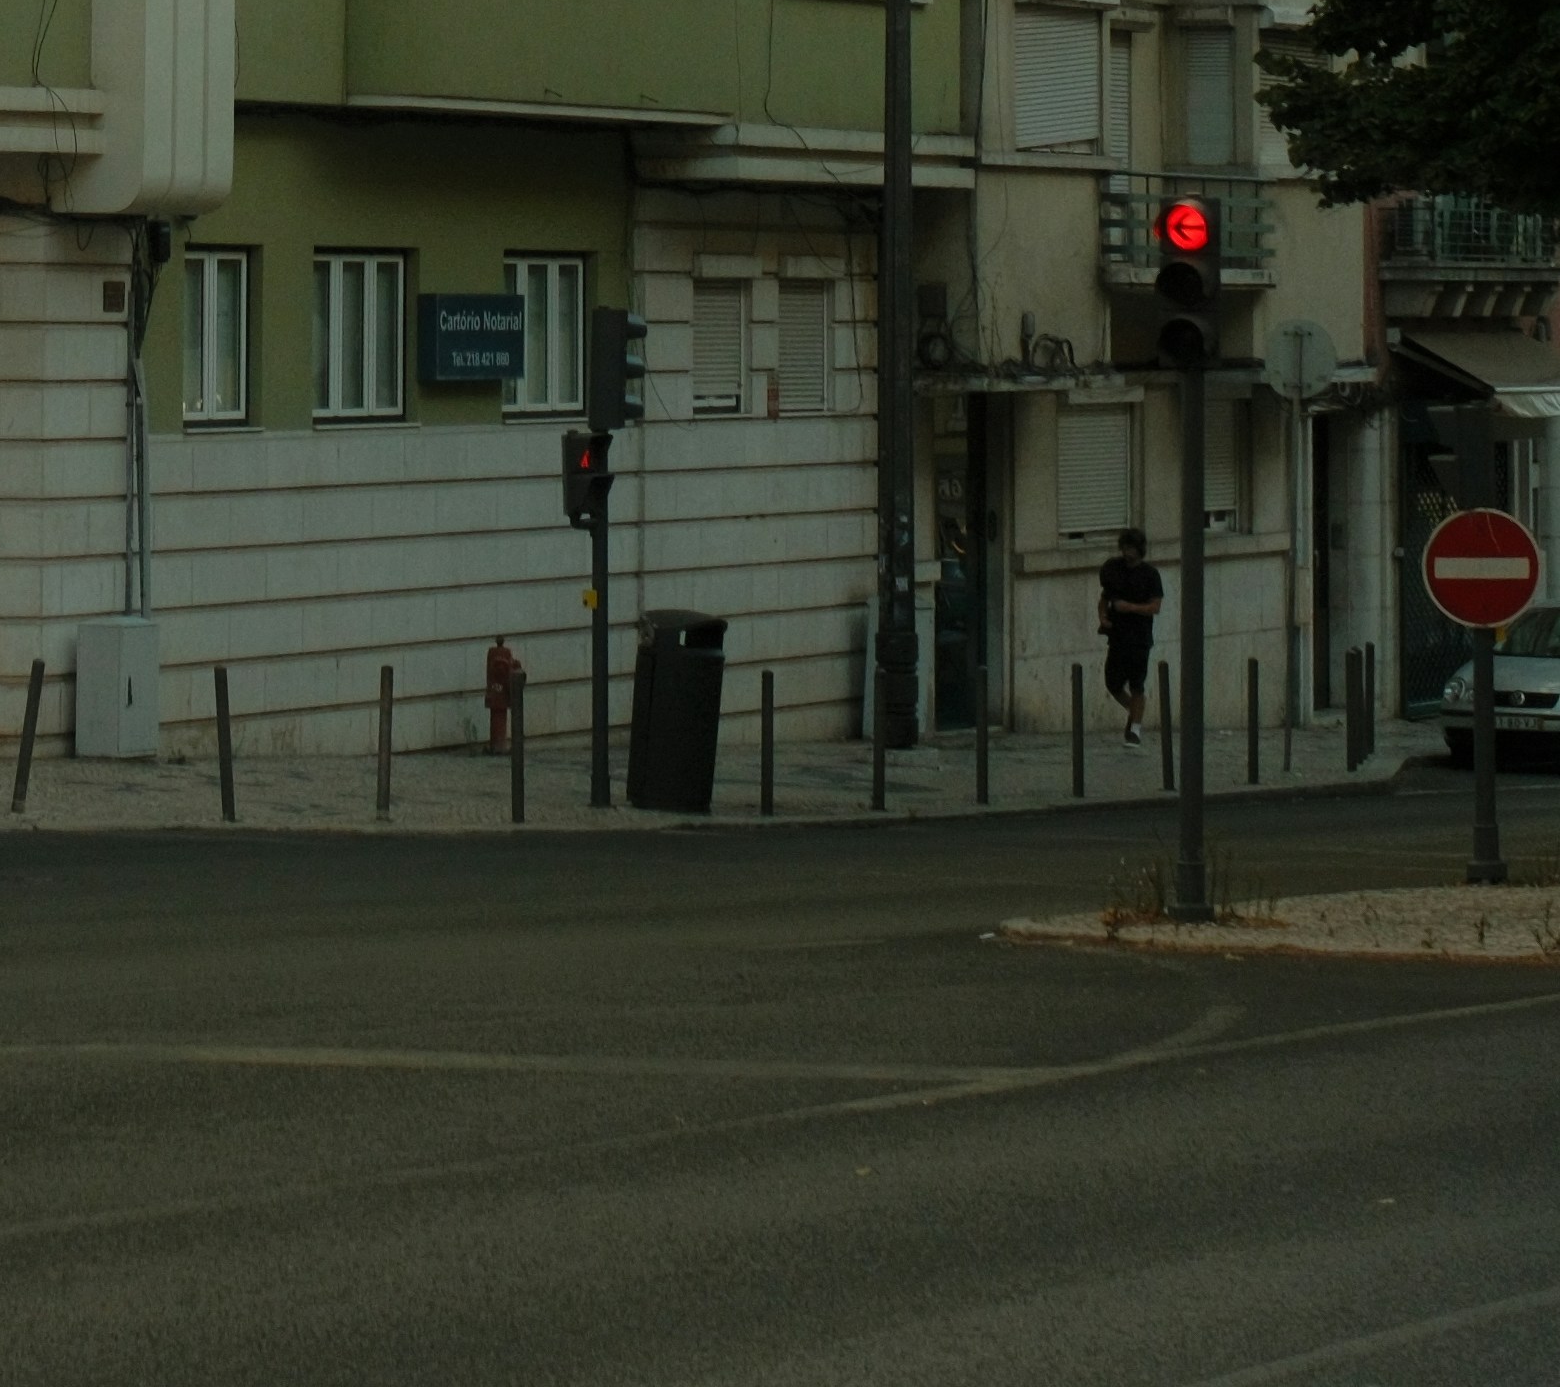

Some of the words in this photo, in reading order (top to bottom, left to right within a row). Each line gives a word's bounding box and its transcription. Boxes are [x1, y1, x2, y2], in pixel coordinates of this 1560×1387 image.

[440, 310, 480, 331] Cartório
[483, 310, 522, 331] Notarial
[467, 351, 480, 366] 218
